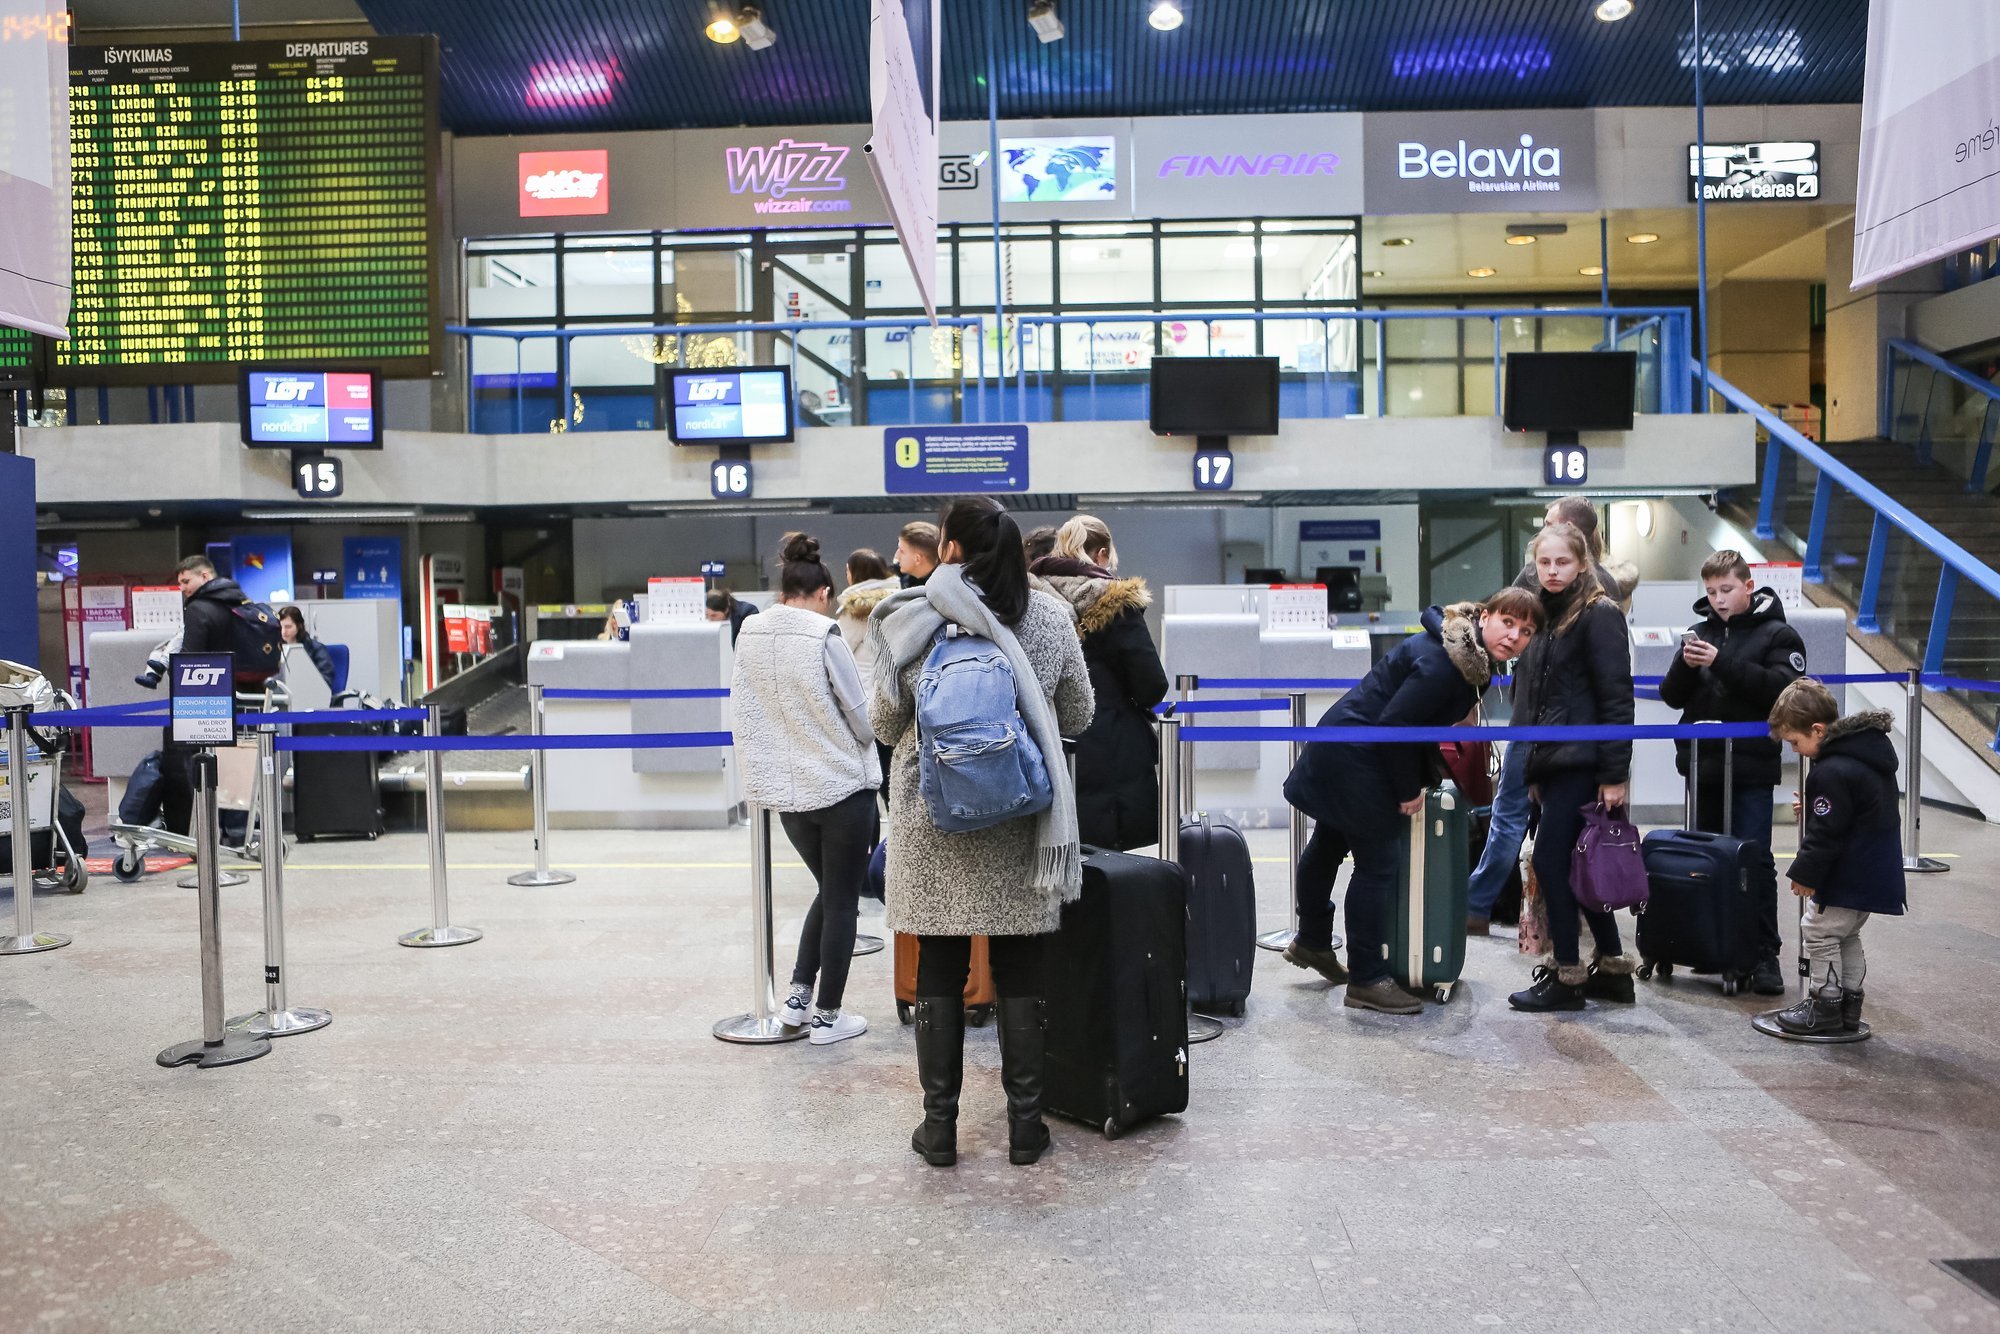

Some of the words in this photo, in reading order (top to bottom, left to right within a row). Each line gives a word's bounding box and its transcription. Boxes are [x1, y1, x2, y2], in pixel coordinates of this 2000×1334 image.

[104, 46, 173, 64] IŠVYKIMAS
[286, 41, 368, 58] DEPARTURES
[112, 84, 140, 95] RIGA
[220, 80, 256, 92] 21:25
[307, 77, 344, 89] 01-02
[69, 100, 97, 111] 3469
[112, 97, 155, 110] LONDON
[221, 94, 257, 107] 22:50
[307, 91, 344, 103] 03-04
[70, 115, 98, 125] 2109
[113, 111, 156, 123] MOSCOW
[170, 110, 192, 122] SVO
[221, 108, 257, 121] 05:10
[70, 129, 91, 139] 350
[113, 126, 142, 138] RIGA
[222, 122, 258, 135] 05:50
[70, 143, 98, 154] 8051
[157, 139, 207, 151] BERGAMO
[222, 137, 258, 149] 06:10
[71, 157, 99, 168] 8093
[114, 155, 136, 167] TEL
[143, 154, 172, 166] AVIV
[186, 152, 208, 164] TLV
[222, 151, 259, 163] 06:15
[1398, 133, 1561, 179] Belavia
[72, 172, 93, 182] 774
[115, 168, 158, 181] WARSAW
[223, 165, 259, 178] 06:25
[1158, 153, 1340, 178] FINNAIR
[72, 186, 94, 196] 743
[115, 181, 188, 195] COPENHAGEN
[202, 180, 216, 192] CP
[223, 179, 260, 192] 06:30
[1468, 180, 1521, 192] Belarusian
[1522, 179, 1561, 192] Airlines
[1751, 182, 1796, 199] baras
[116, 196, 180, 209] FRANKFURT
[224, 193, 260, 206] 06:35
[753, 197, 852, 214] wizzair.com
[73, 213, 101, 224] 1501
[116, 211, 145, 223] OSLO
[159, 210, 181, 222] OSL
[224, 208, 260, 220] 06:40
[74, 227, 95, 238] 101
[225, 222, 261, 234] 07:00
[74, 241, 102, 252] 8001
[117, 239, 160, 252] LONDON
[225, 236, 261, 248] 07:00
[75, 255, 103, 266] 7149
[118, 253, 161, 266] DUBLIN
[175, 252, 197, 264] DUB
[225, 250, 262, 262] 07:10
[75, 269, 103, 281] 8025
[118, 267, 183, 280] EINDHOVEN
[190, 265, 212, 278] EIN
[226, 264, 262, 276] 07:10
[119, 281, 147, 294] KIEV
[226, 278, 262, 291] 07:15
[77, 298, 105, 309] 3441
[227, 292, 263, 305] 07:30
[77, 311, 98, 323] 609
[120, 309, 185, 322] AMSTERDAM
[227, 306, 263, 319] 07:40
[120, 323, 163, 336] WARSAW
[228, 320, 264, 333] 10:05
[78, 339, 107, 351] 1761
[228, 335, 264, 347] 10:25
[57, 355, 71, 366] BT
[79, 353, 100, 365] 342
[121, 352, 150, 364] RIGA
[228, 348, 265, 361] 10:30
[265, 382, 315, 401] LOT
[687, 381, 733, 401] LOT
[1197, 456, 1231, 484] 17
[1551, 451, 1585, 479] 18
[300, 463, 336, 492] 15
[714, 465, 748, 493] 16
[180, 668, 226, 686] LOT
